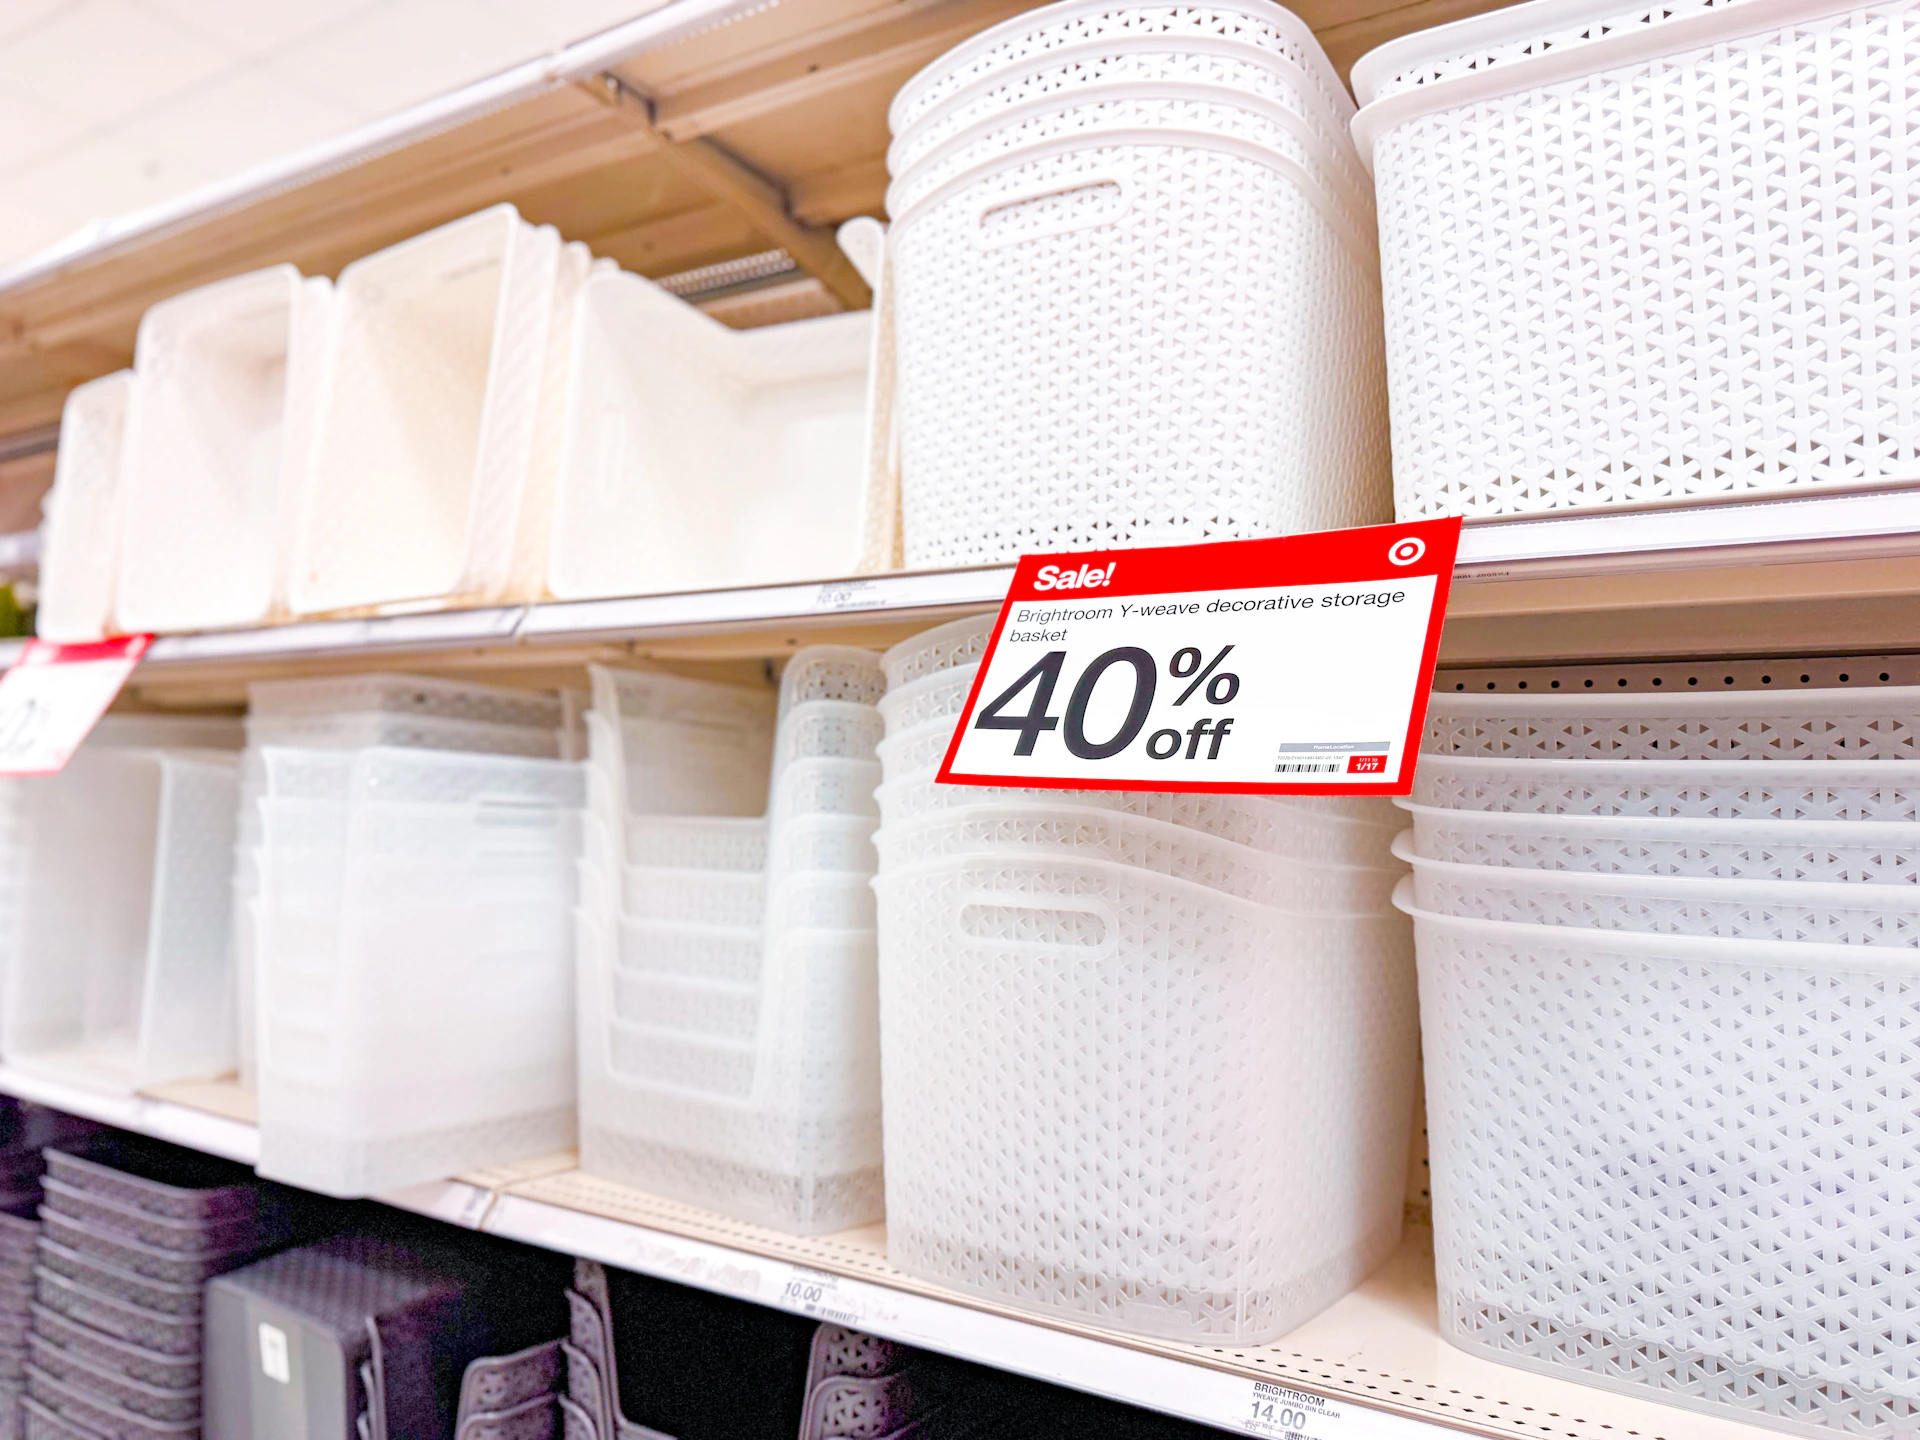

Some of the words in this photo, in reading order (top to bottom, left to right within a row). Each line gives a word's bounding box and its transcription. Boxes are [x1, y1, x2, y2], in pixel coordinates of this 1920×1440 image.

[1033, 562, 1117, 592] Sale!
[1016, 608, 1113, 625] Brightroom
[1120, 603, 1200, 618] Y-weave
[1206, 595, 1315, 613] decorative
[1320, 591, 1405, 608] storage
[1009, 628, 1068, 643] basket
[1145, 718, 1235, 760] off
[1355, 762, 1379, 771] 1/17
[785, 1281, 822, 1303] 10.00
[1252, 1391, 1279, 1404] YWEAVE
[1279, 1399, 1304, 1410] JUMBO
[1304, 1405, 1317, 1413] BIN
[1317, 1408, 1341, 1419] CLEAR
[1253, 1382, 1325, 1407] BRIGHTROOM
[1251, 1401, 1306, 1430] 14.00
